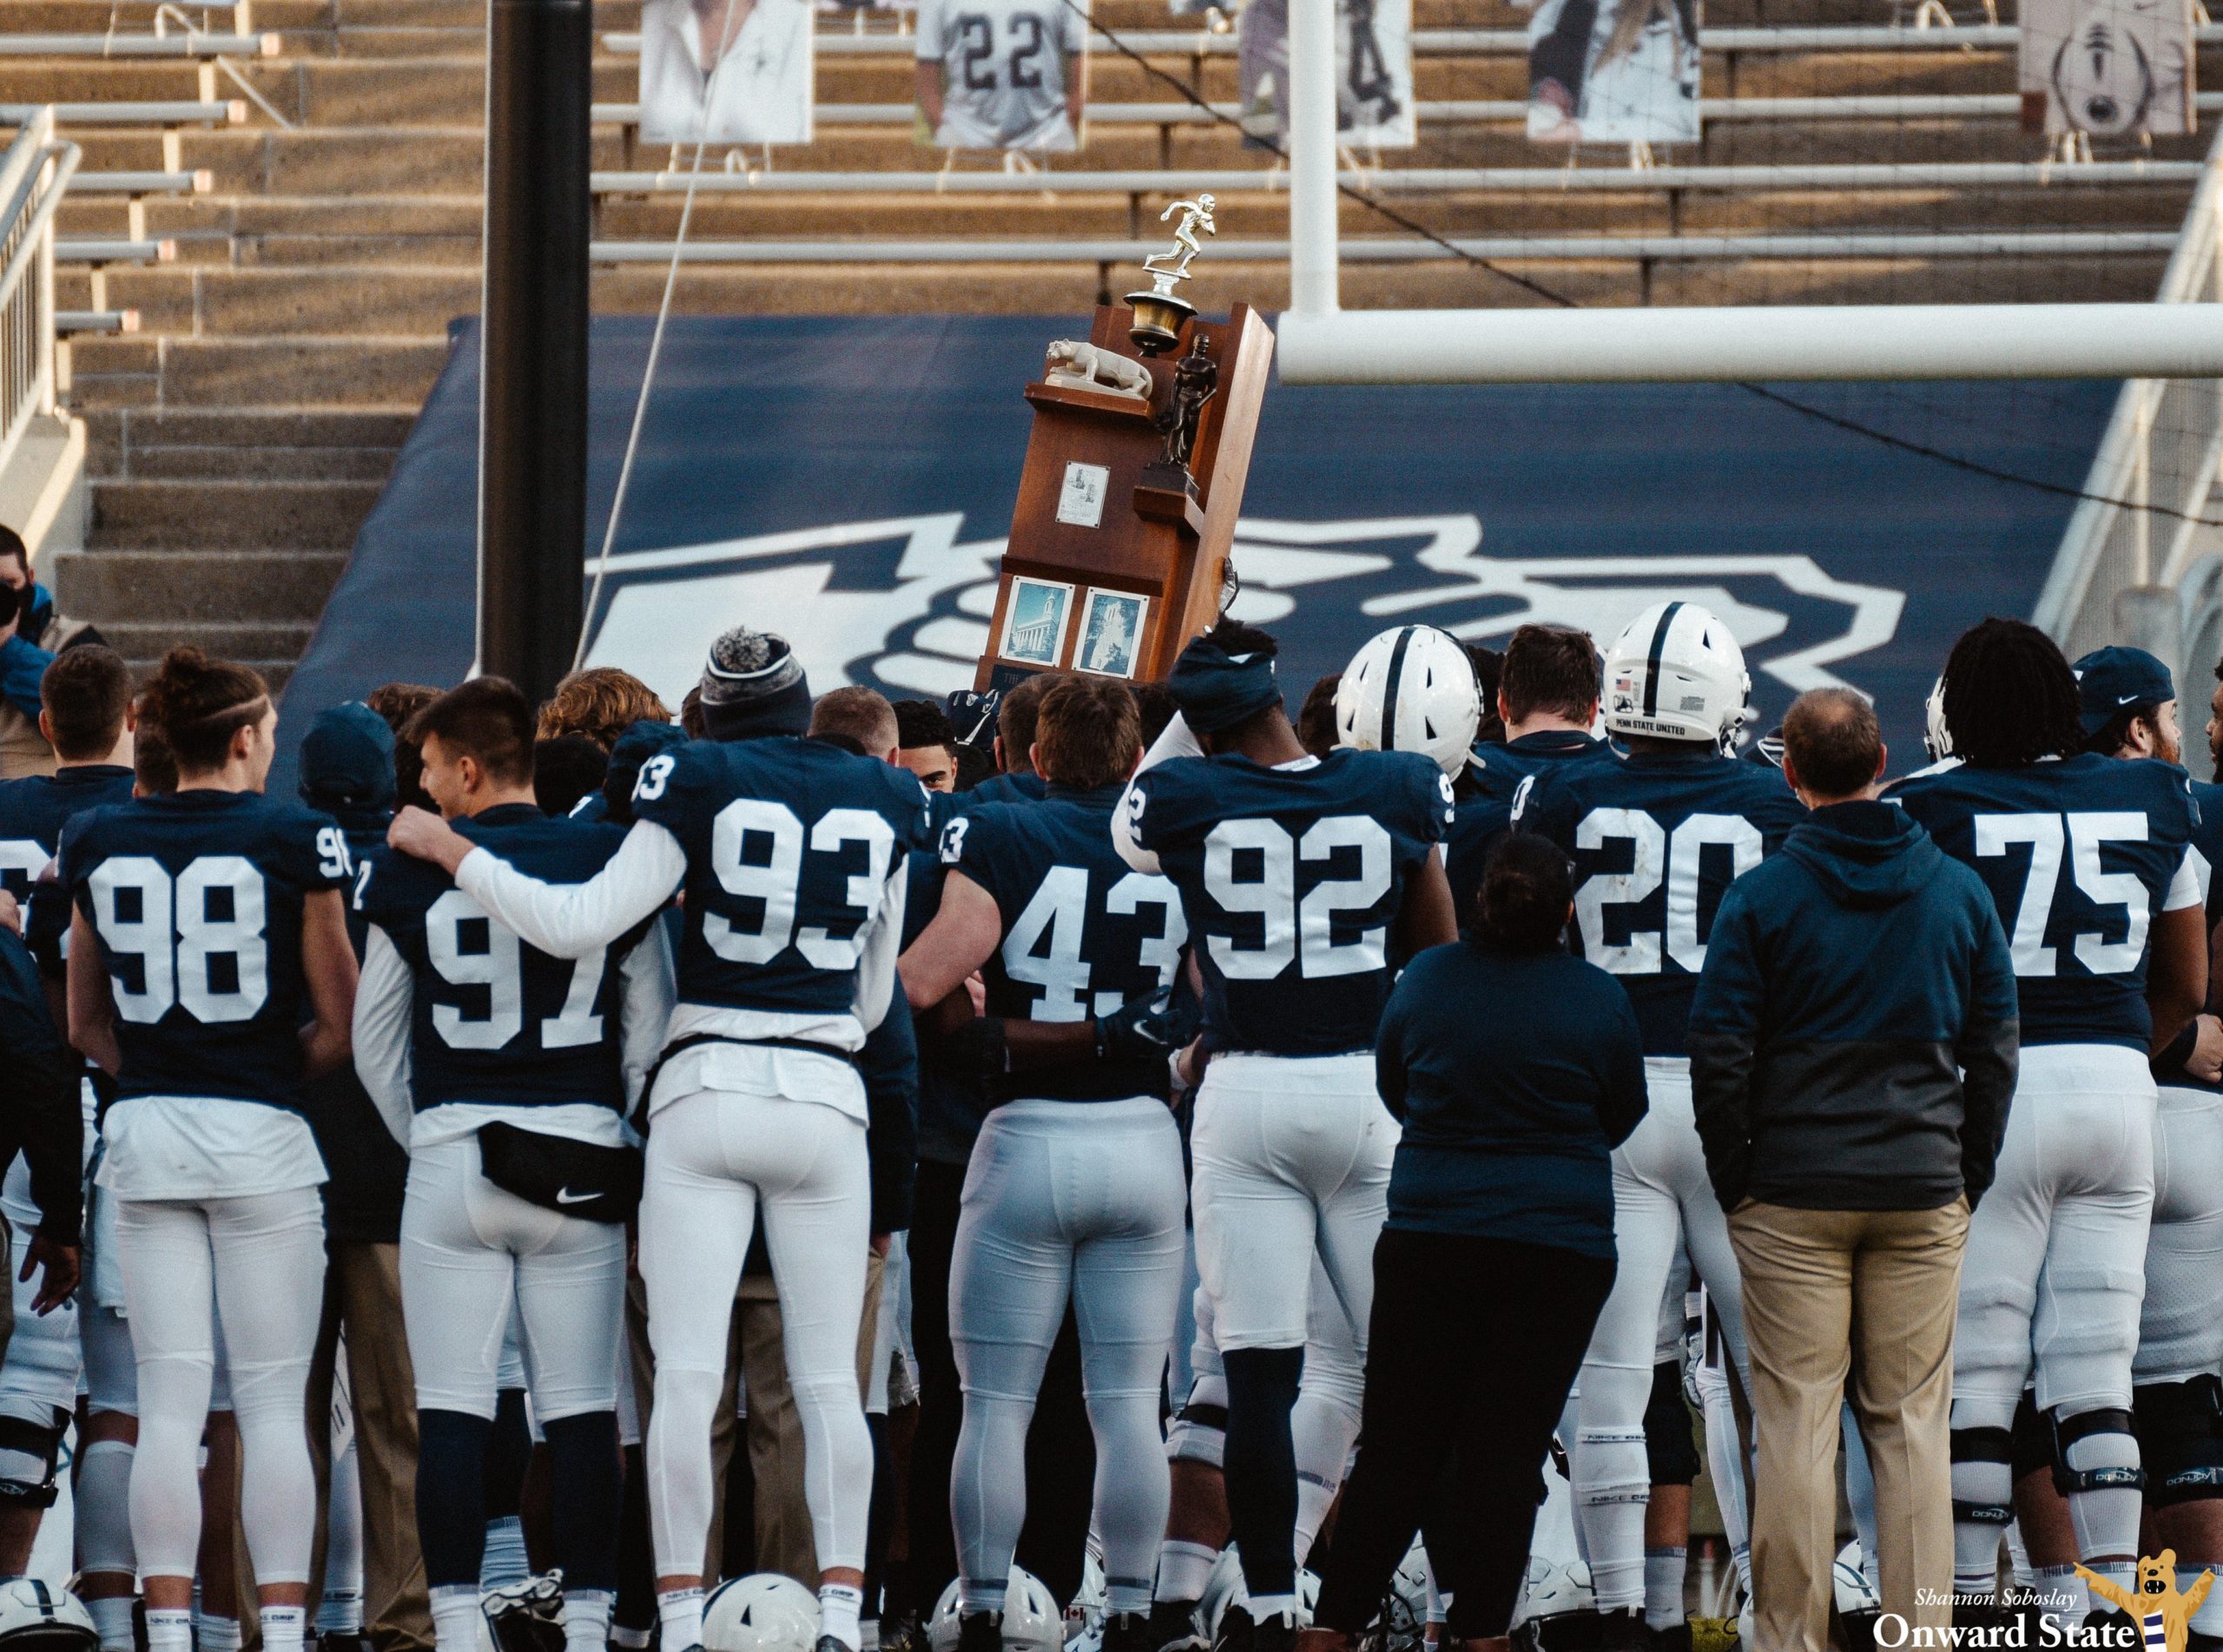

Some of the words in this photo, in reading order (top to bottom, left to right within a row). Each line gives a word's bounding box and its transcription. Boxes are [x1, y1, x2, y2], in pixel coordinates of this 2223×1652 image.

[957, 12, 1042, 89] 22
[1616, 719, 1632, 728] PENN
[1633, 720, 1654, 731] STATE
[1656, 724, 1685, 735] UNITED
[88, 856, 268, 1024] 98
[703, 798, 895, 971] 93
[1001, 865, 1189, 1023] 43
[1204, 814, 1392, 980] 92
[1573, 806, 1763, 974] 20
[1975, 812, 2150, 977] 75
[425, 889, 608, 1050] 97
[2167, 1471, 2213, 1486] DONJOY
